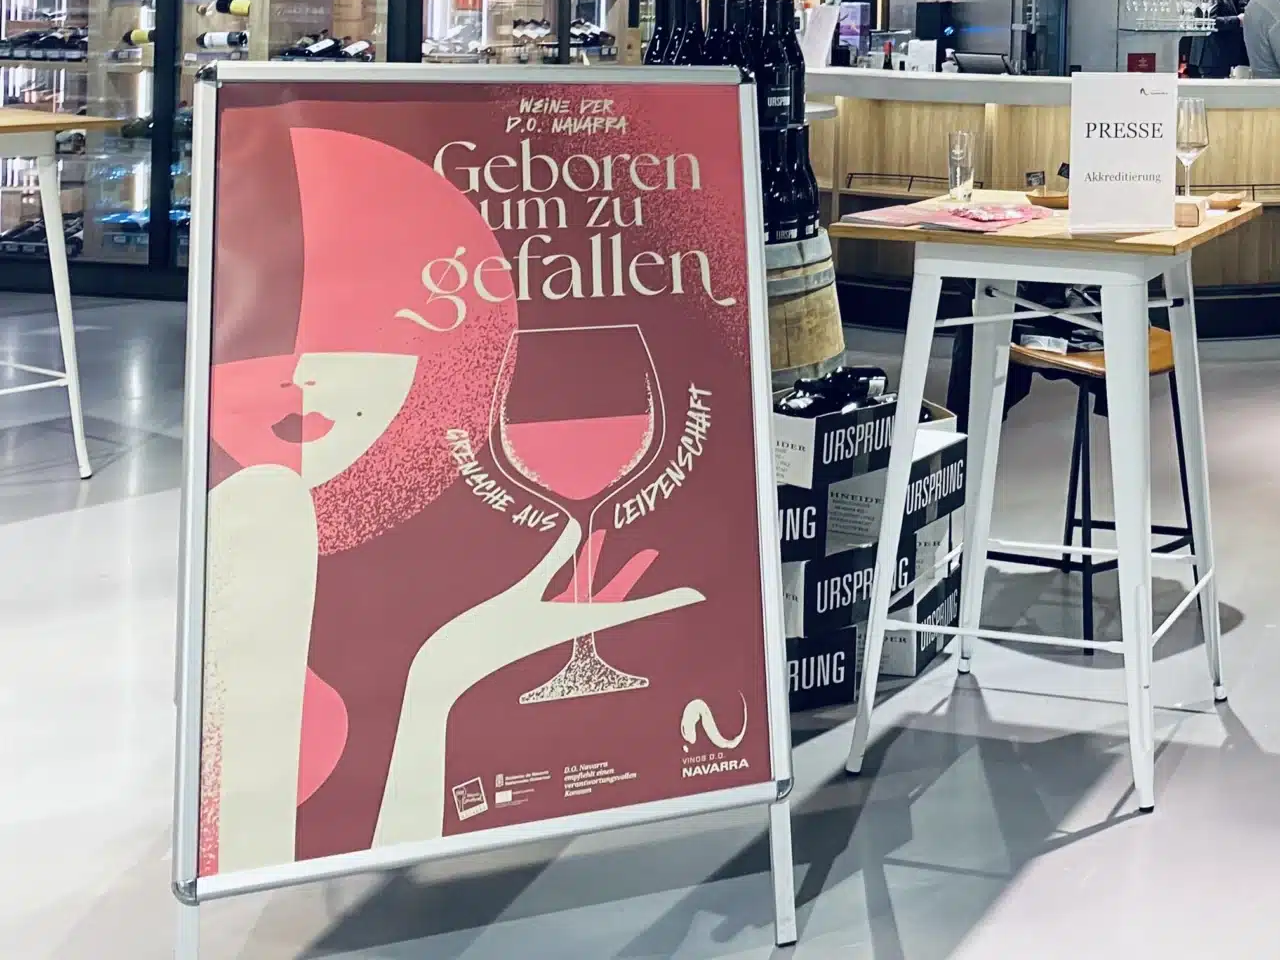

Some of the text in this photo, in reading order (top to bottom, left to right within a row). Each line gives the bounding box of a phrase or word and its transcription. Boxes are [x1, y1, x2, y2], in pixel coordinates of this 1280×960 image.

[505, 115, 629, 136] D.O. NAVARRA
[579, 98, 614, 114] DER
[1085, 122, 1164, 139] PRESSE
[432, 138, 702, 194] Geboren
[1084, 171, 1162, 184] Akkreditierung
[479, 195, 644, 231] um zu
[394, 232, 737, 332] gefallen
[613, 380, 712, 529] LEIDENSCHAFT
[822, 415, 896, 465] URSPRUN
[445, 428, 559, 532] GRENACHE AUS
[905, 459, 964, 515] URSPRUNG
[816, 567, 874, 614] URSPR
[787, 651, 846, 692] RUNG
[682, 755, 706, 765] VINOS
[682, 758, 749, 778] NAVARRA
